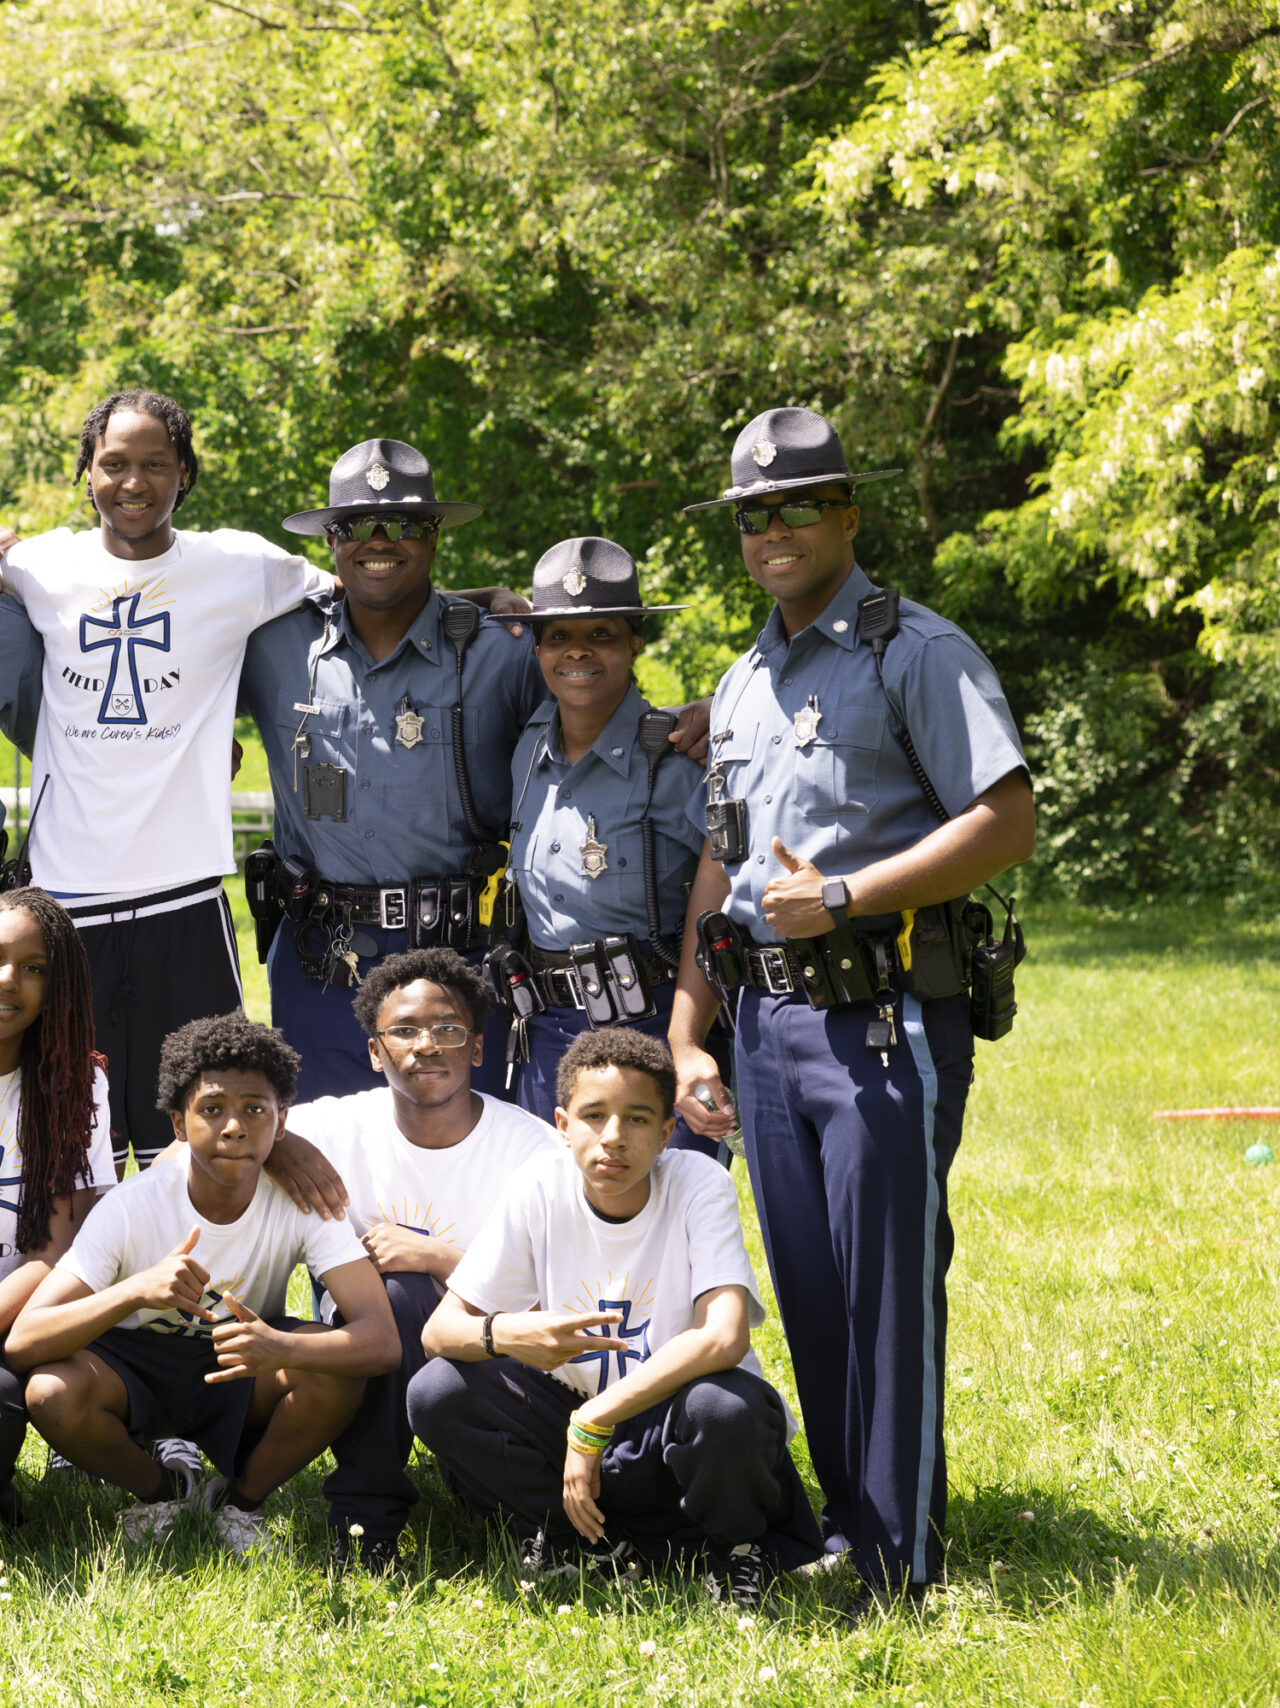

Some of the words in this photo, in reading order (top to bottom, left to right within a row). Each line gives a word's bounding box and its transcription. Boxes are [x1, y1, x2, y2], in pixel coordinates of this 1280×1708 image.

[62, 666, 104, 692] FIELD
[143, 667, 180, 693] DAY
[65, 725, 79, 738] We
[81, 729, 97, 739] are
[100, 726, 142, 741] Corey's
